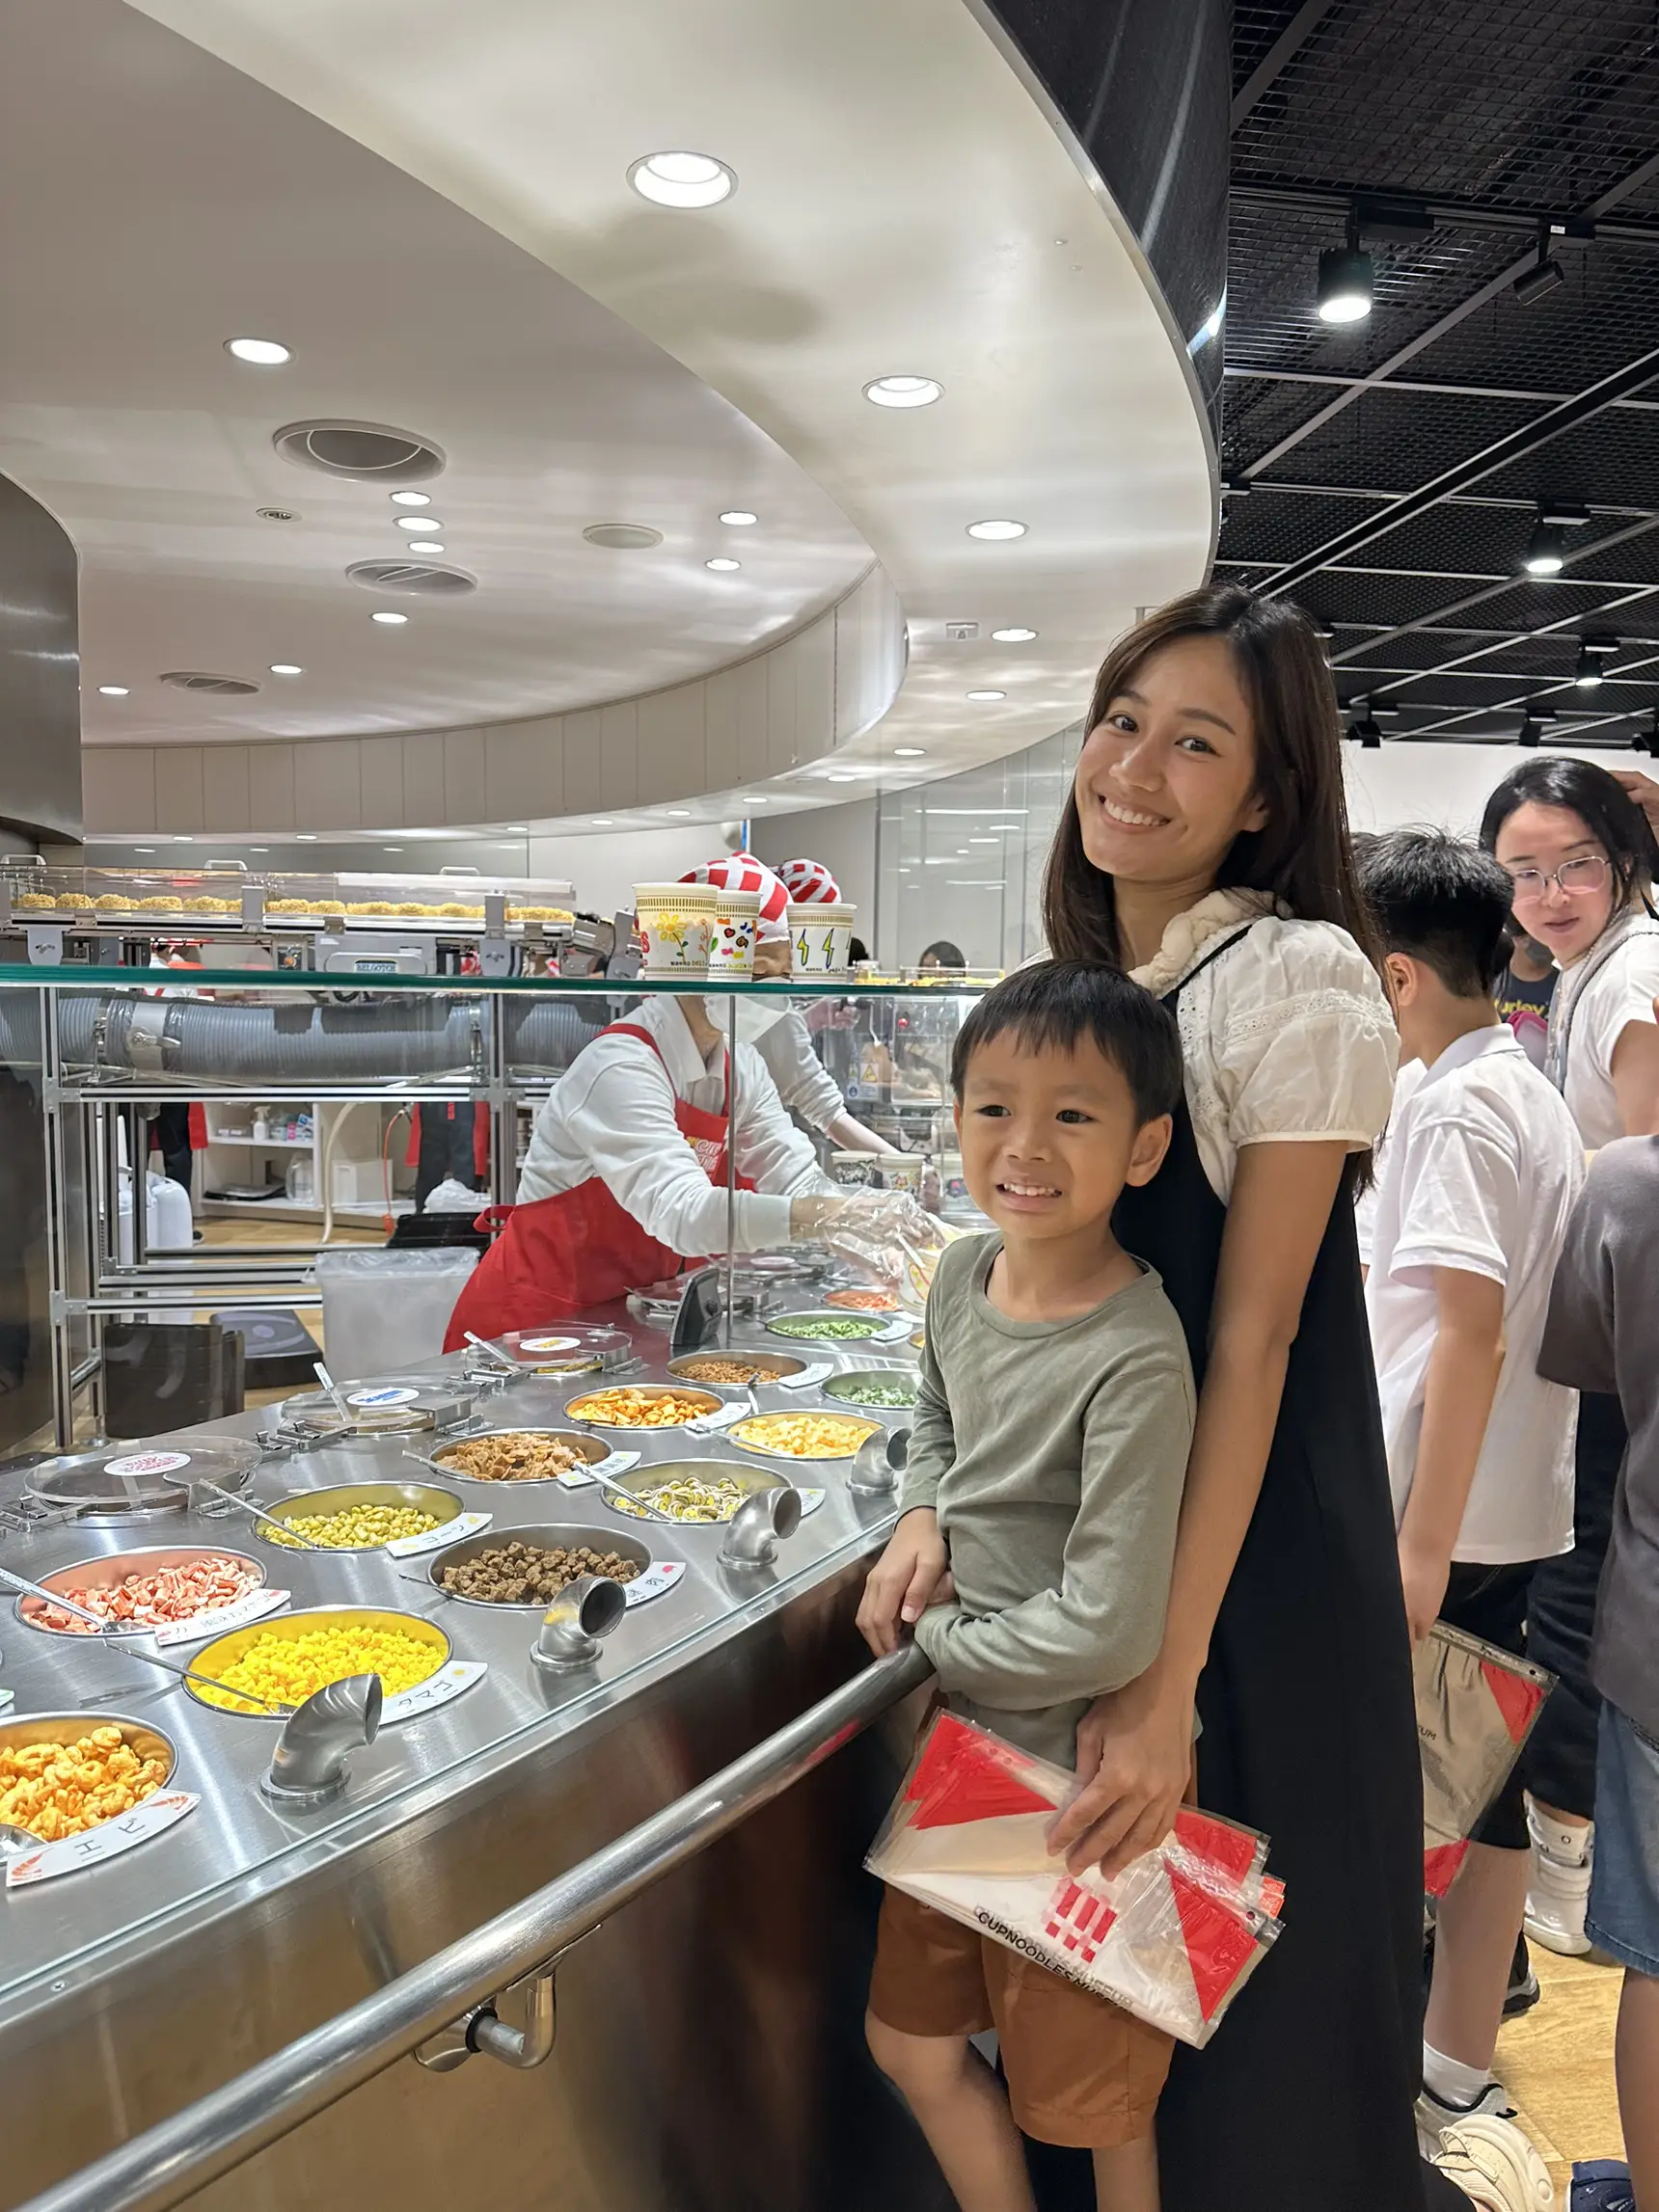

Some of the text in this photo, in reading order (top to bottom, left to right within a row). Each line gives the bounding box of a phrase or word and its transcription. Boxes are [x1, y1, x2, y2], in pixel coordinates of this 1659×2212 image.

[1494, 998, 1545, 1015] urley
[398, 1680, 453, 1708] タマゴ
[74, 1818, 146, 1855] エビ
[978, 1911, 1073, 1980] CUPNOODLES
